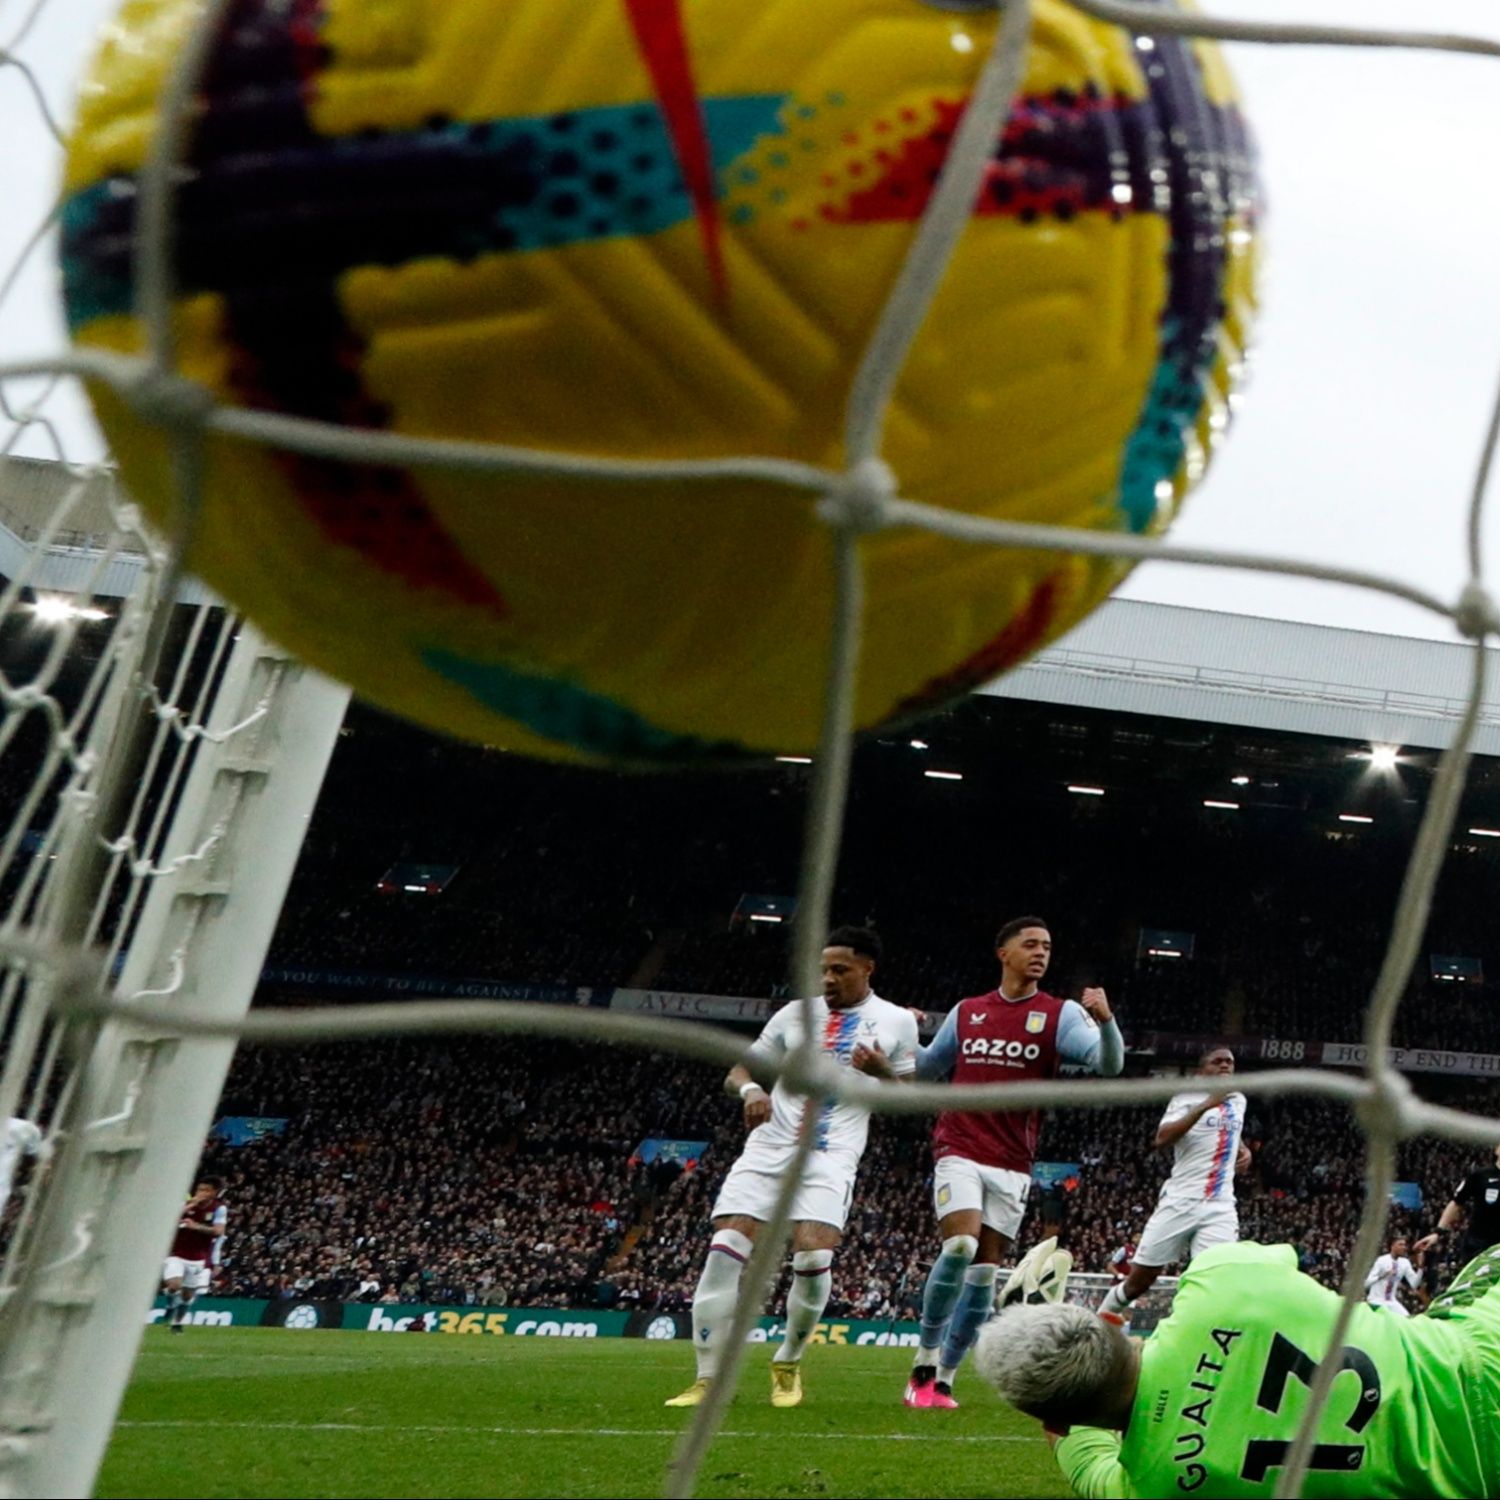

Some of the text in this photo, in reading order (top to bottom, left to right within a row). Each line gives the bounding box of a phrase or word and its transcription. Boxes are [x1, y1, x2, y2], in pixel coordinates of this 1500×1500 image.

[962, 1038, 1040, 1060] CAZOO
[1260, 1039, 1305, 1060] 1888
[1338, 1050, 1404, 1065] HOE
[1416, 1055, 1457, 1069] END
[367, 1307, 598, 1337] bet365com
[1174, 1328, 1242, 1492] GUAITA
[1240, 1332, 1381, 1482] 13
